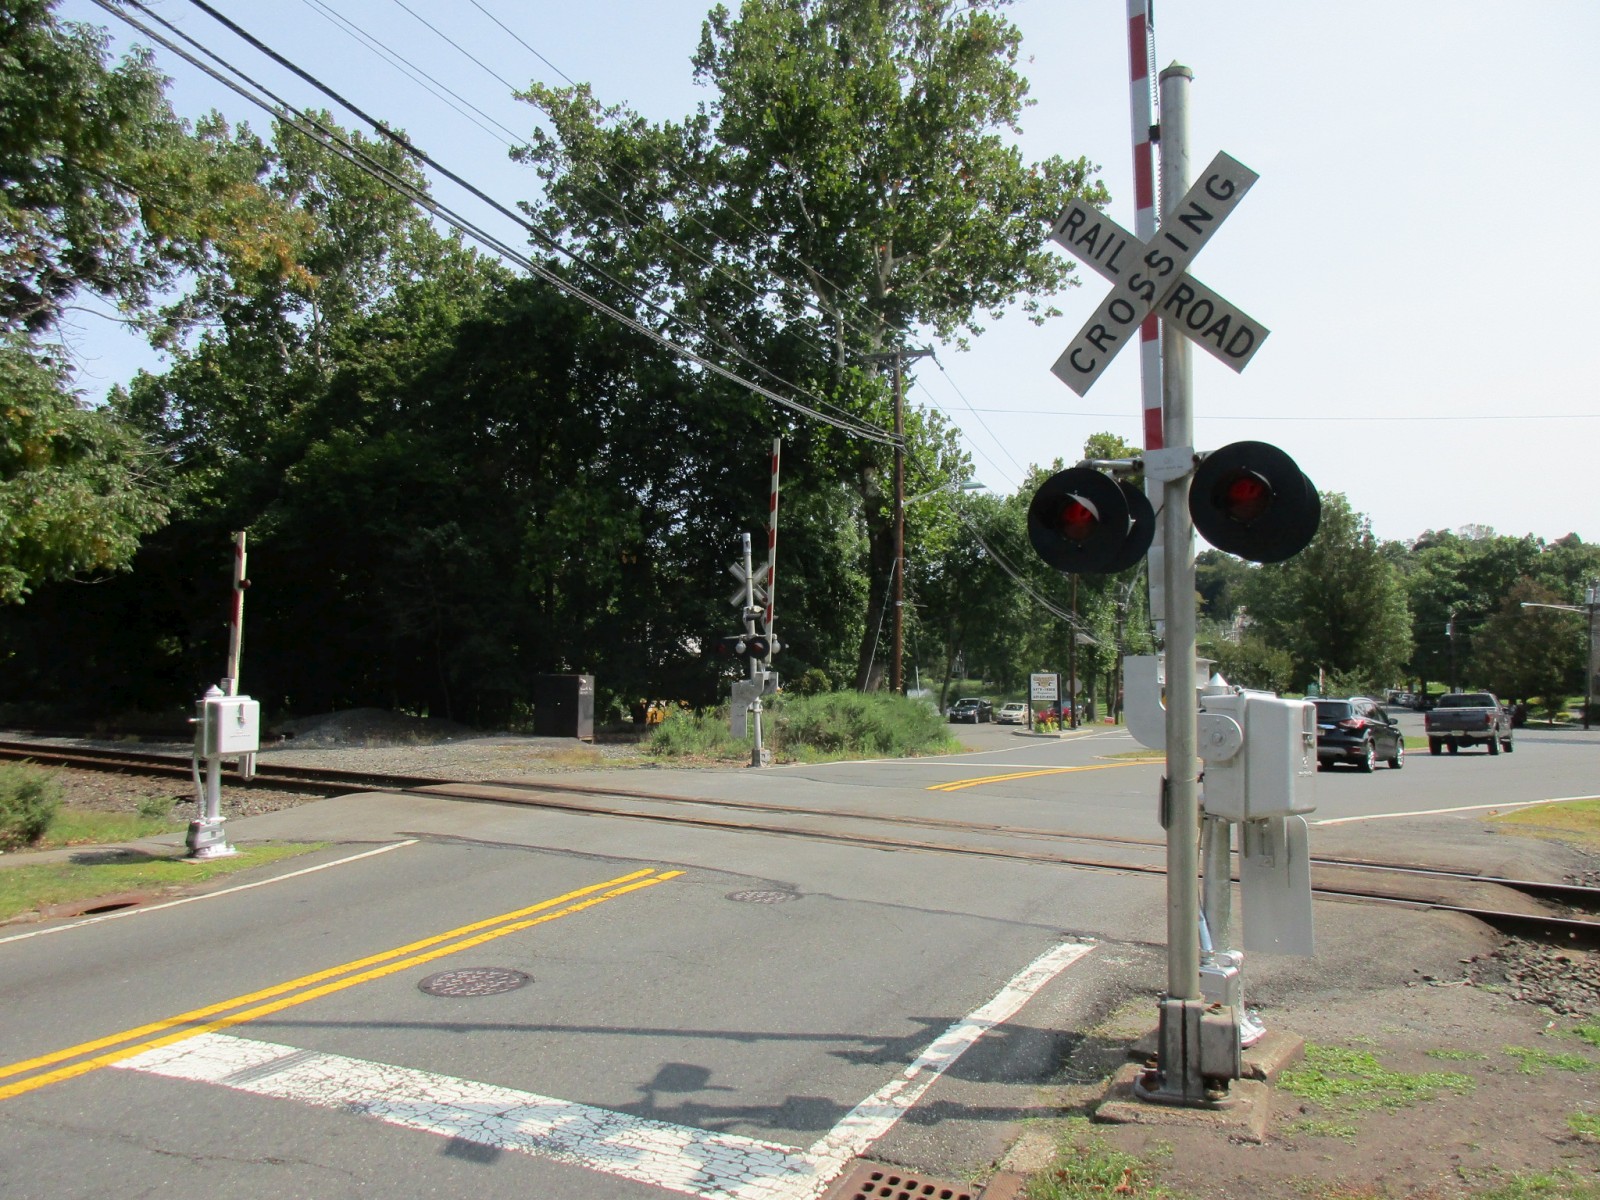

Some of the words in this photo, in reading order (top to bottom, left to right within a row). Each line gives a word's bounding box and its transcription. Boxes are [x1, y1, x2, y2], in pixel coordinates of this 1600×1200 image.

[1059, 207, 1126, 275] RAIL
[1164, 282, 1255, 358] ROAD
[1070, 174, 1235, 374] CROSSING
